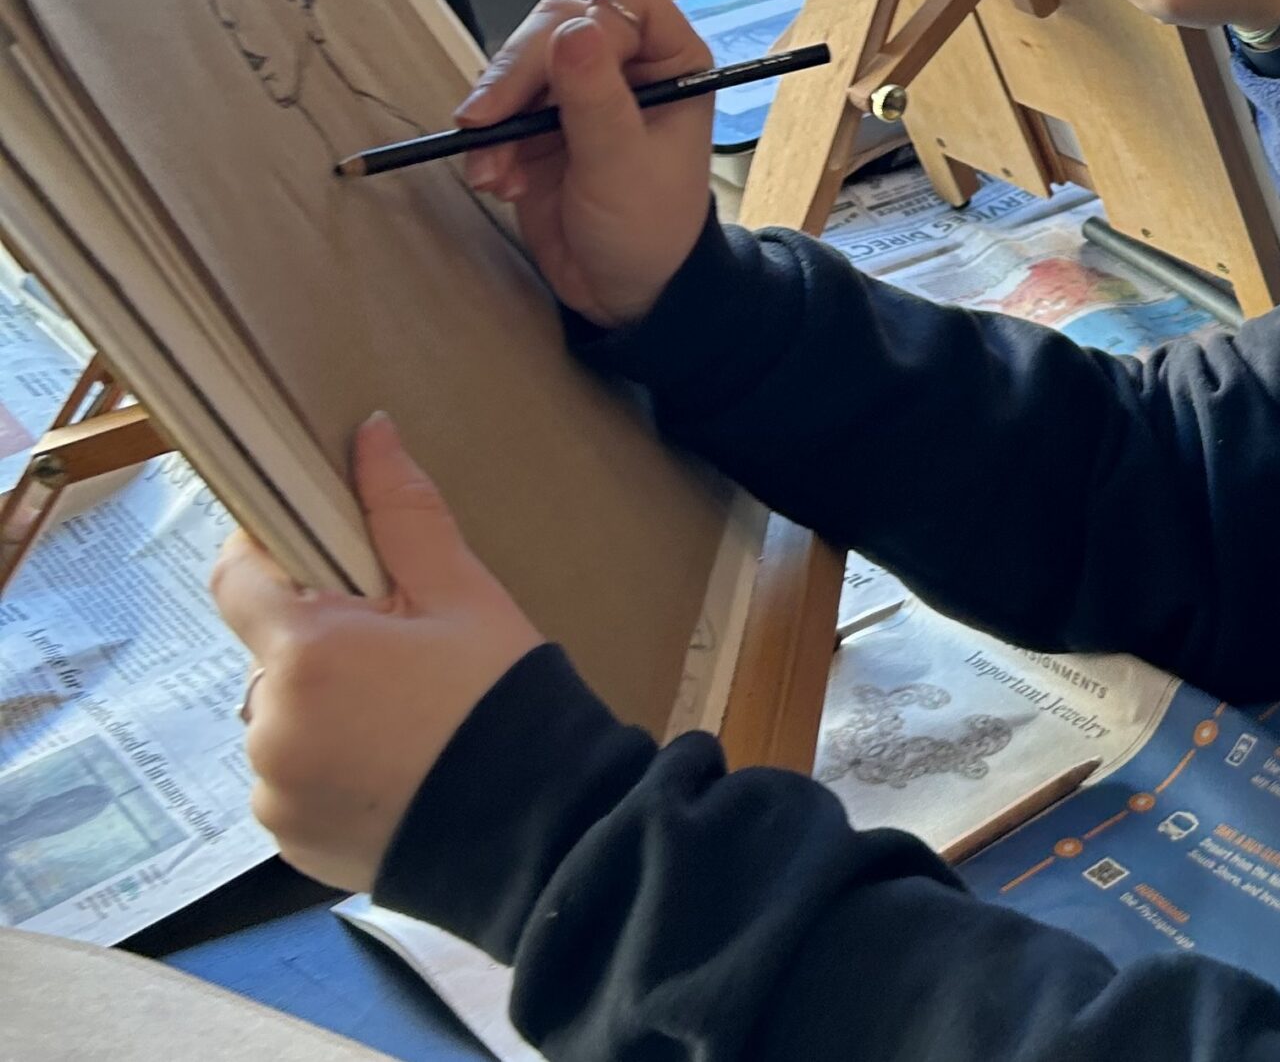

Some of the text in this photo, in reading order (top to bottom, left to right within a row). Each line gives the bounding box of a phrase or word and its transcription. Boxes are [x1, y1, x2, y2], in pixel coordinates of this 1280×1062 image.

[849, 190, 1036, 258] ERVICES DIRECT
[57, 668, 84, 689] for
[1013, 647, 1109, 699] SIGNMENTS
[964, 650, 1111, 739] Important Jewelry
[130, 749, 165, 768] off
[144, 760, 169, 781] in
[155, 777, 194, 810] many
